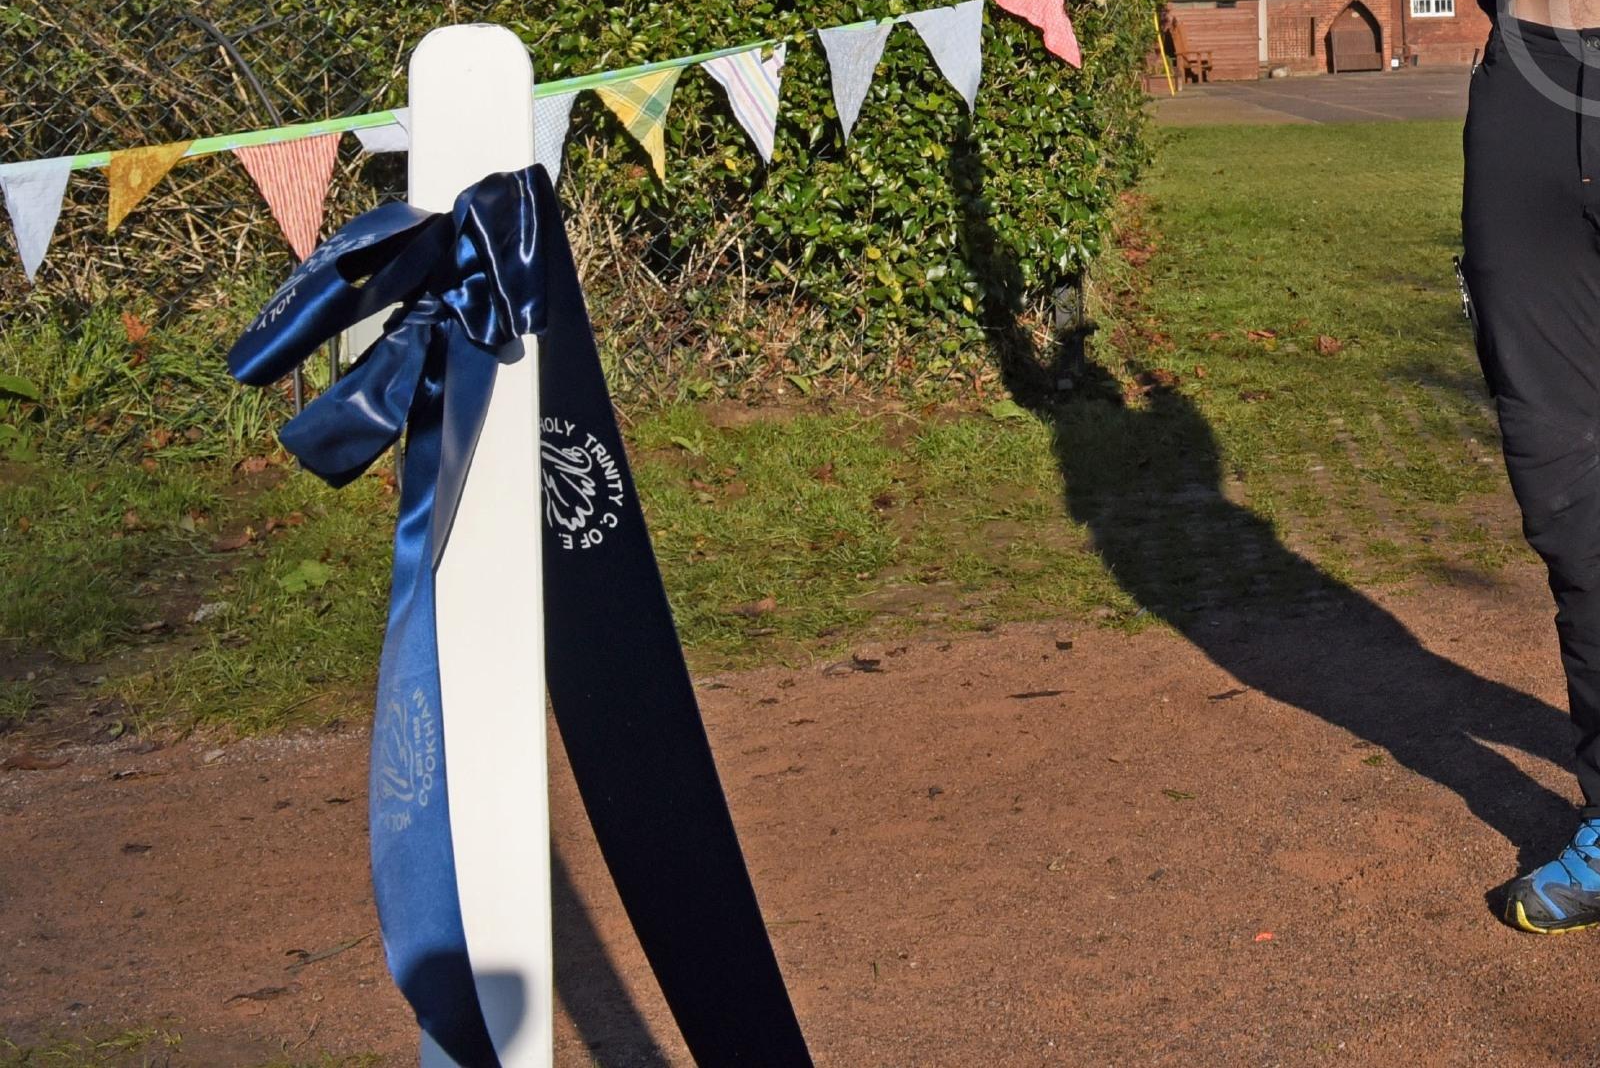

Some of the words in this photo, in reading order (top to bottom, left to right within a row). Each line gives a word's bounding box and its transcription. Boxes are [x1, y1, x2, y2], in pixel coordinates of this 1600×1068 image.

[584, 433, 625, 507] TRINITY
[580, 528, 604, 549] OF
[412, 687, 436, 807] COOKHAM
